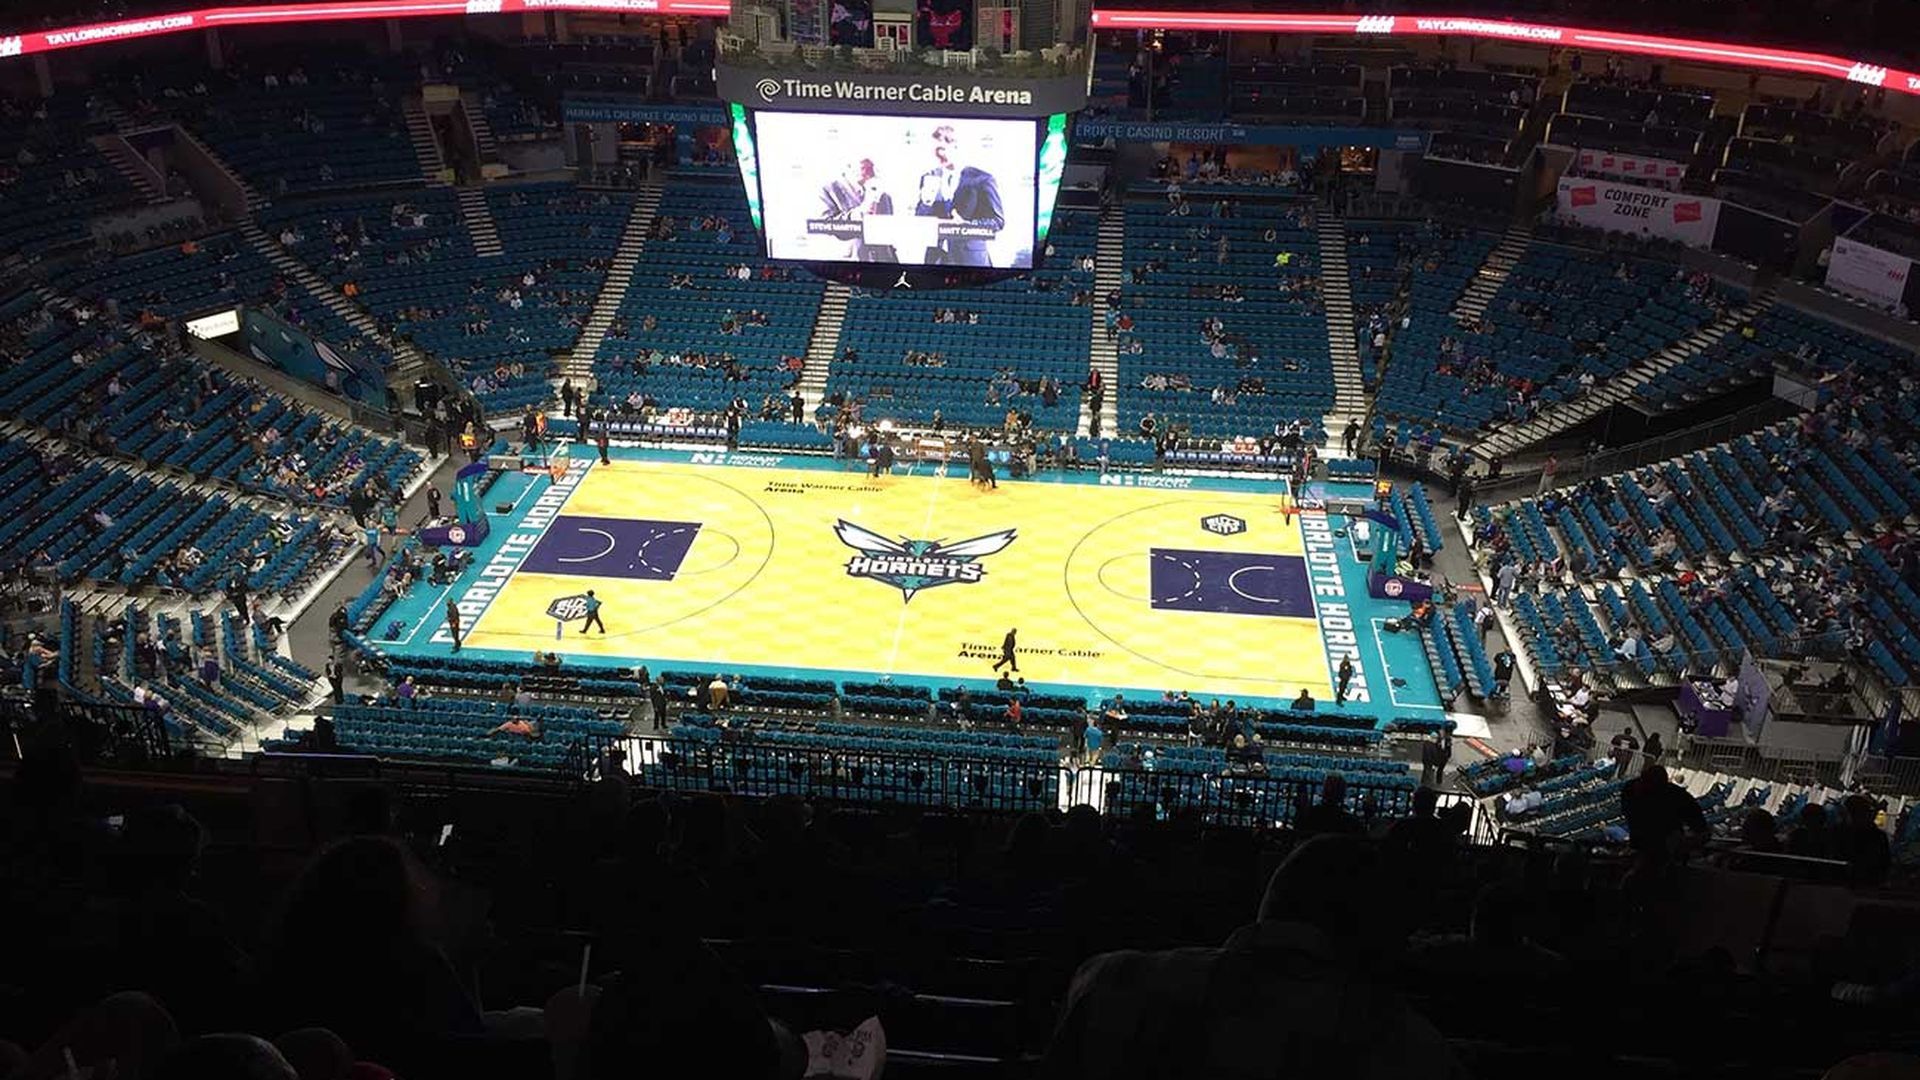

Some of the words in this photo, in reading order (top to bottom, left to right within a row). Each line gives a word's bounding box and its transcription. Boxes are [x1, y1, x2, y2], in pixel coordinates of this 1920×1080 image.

[783, 79, 832, 98] Time
[835, 81, 907, 100] Warner
[909, 84, 964, 102] Cable
[969, 86, 1032, 105] Arena
[663, 111, 698, 122] CASINO
[1075, 124, 1123, 137] EROKEE
[1126, 126, 1172, 139] CASINO
[1177, 127, 1225, 140] RESORT
[1604, 188, 1669, 209] COMFORT
[1613, 203, 1650, 218] ZONE
[764, 486, 804, 494] Arena
[801, 482, 845, 490] Warner
[847, 485, 883, 493] Cable
[851, 557, 982, 581] HORNETS
[960, 642, 997, 651] Time
[1014, 647, 1054, 656] arner
[1057, 648, 1101, 658] Cable
